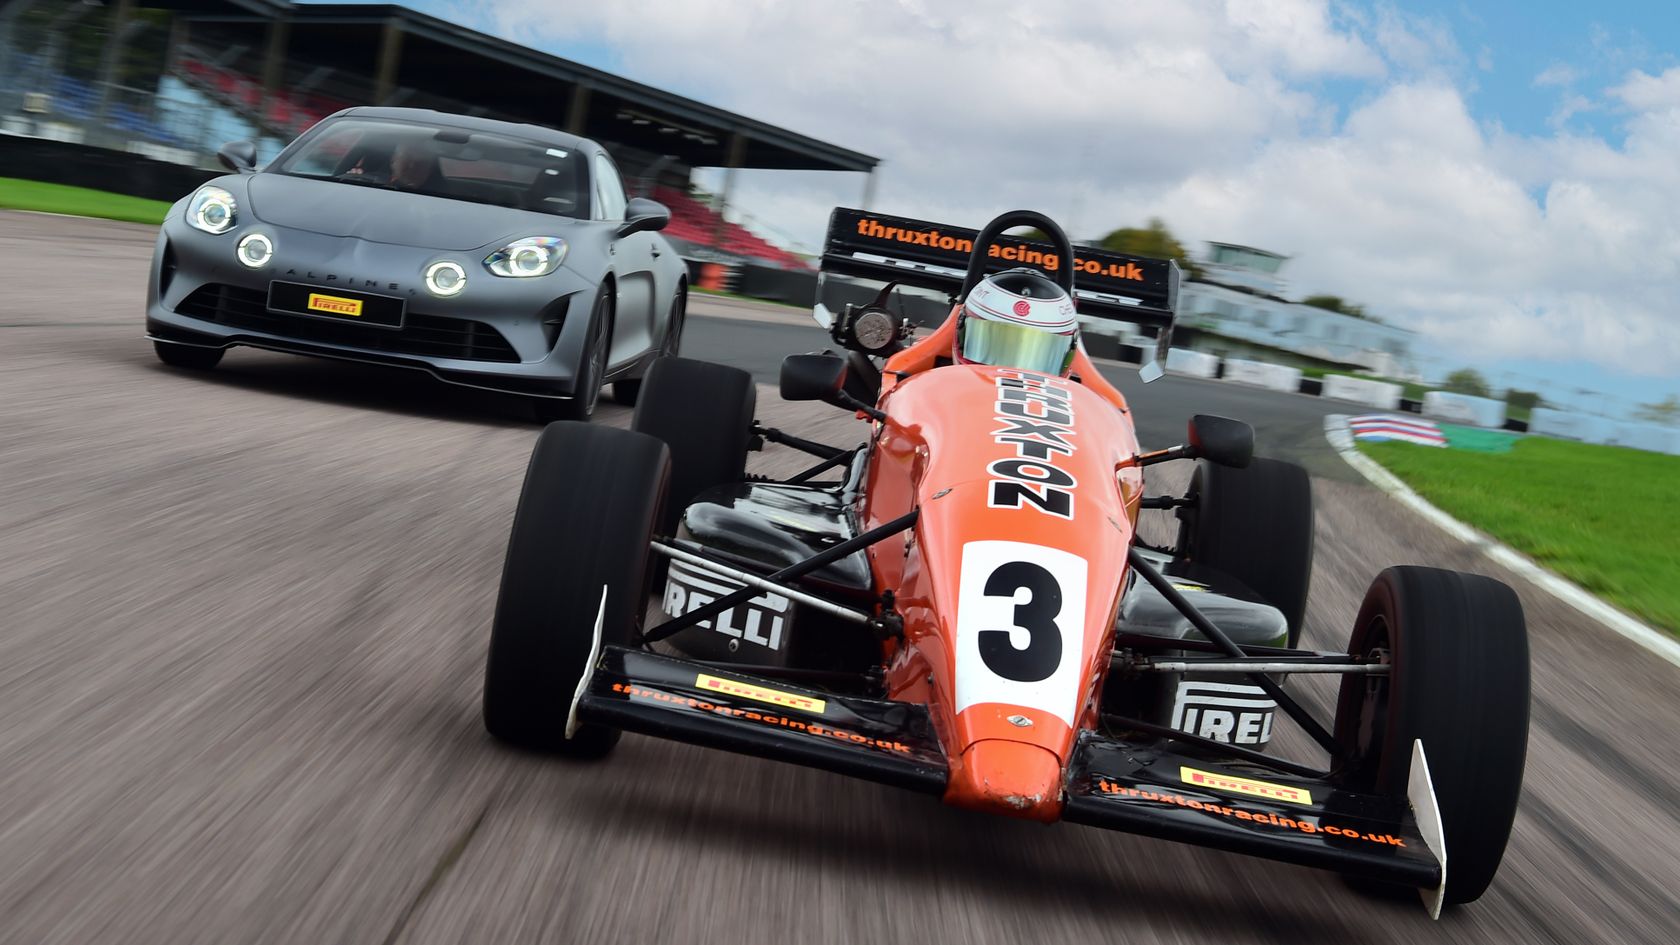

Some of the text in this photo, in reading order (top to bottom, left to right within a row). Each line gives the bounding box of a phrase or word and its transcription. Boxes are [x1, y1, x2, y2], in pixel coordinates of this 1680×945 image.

[286, 268, 400, 290] ALPINE
[857, 218, 1145, 282] thruxtonacingco.uk
[313, 297, 358, 313] PIRELLI
[978, 561, 1063, 683] 3
[611, 682, 911, 753] thruxtonracing.co.uk
[1099, 779, 1407, 848] thruxtonracing.co.uk
